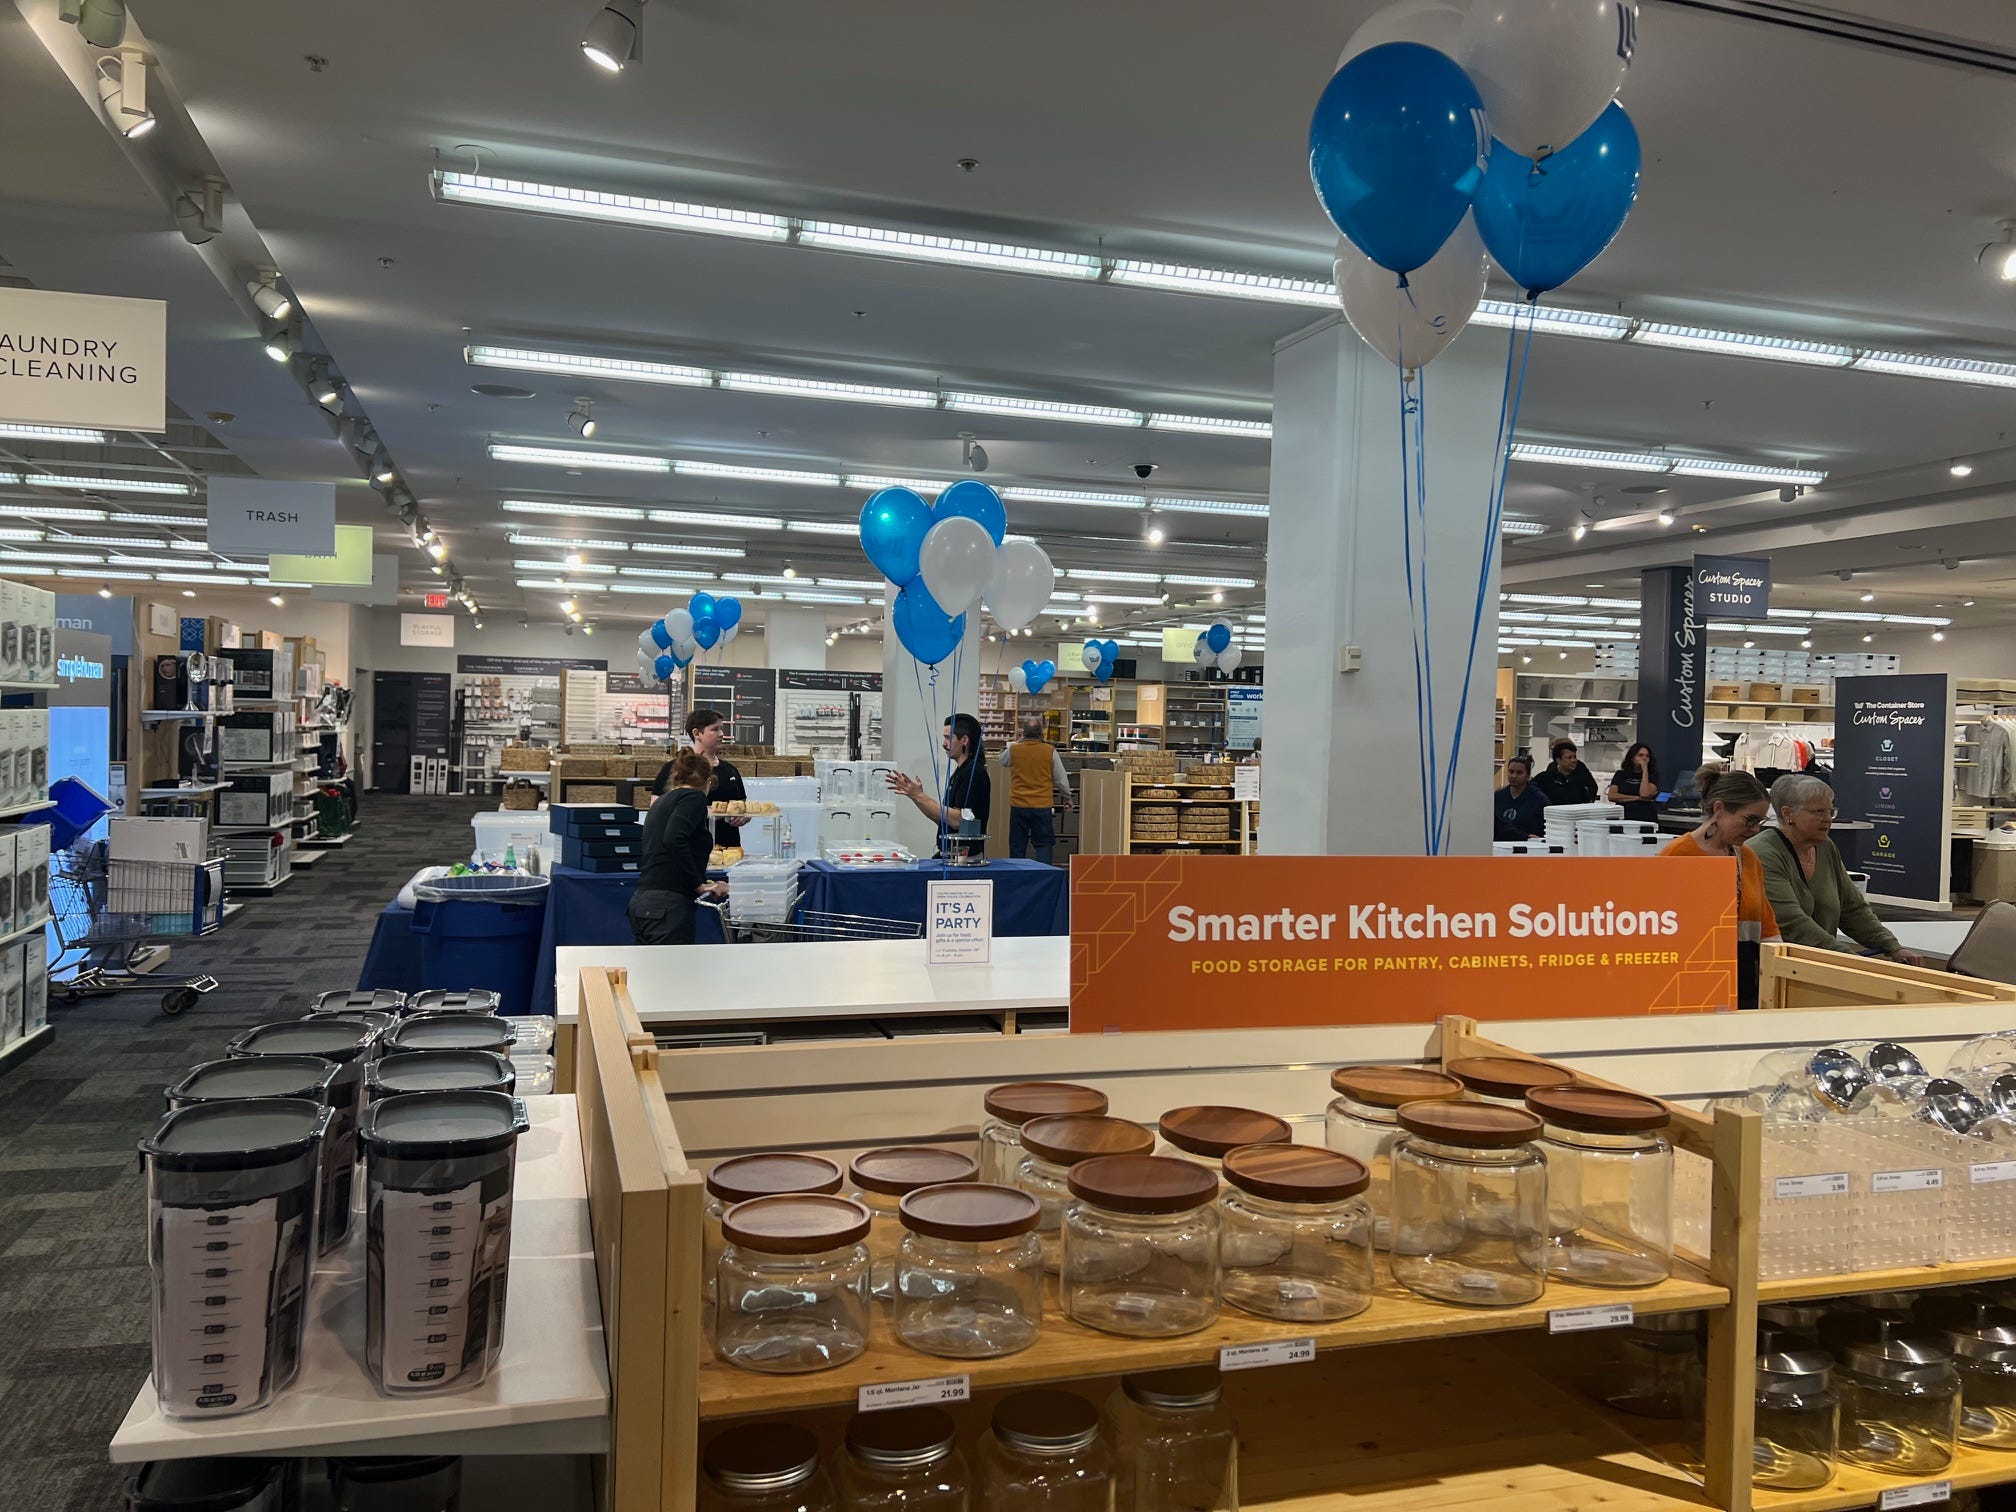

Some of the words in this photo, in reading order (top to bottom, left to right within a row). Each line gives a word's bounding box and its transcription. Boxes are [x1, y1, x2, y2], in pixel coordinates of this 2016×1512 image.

[246, 510, 298, 523] TRASH
[1698, 569, 1731, 585] Custom
[1732, 572, 1763, 591] Spaces
[1709, 592, 1751, 604] STUDIO
[1675, 575, 1705, 649] Spaces
[57, 653, 104, 683] simplehuman
[1672, 652, 1696, 728] Custom
[1877, 701, 1907, 709] Container
[1907, 701, 1925, 709] Store
[1853, 710, 1888, 725] Custom
[1889, 711, 1925, 730] Spaces
[936, 902, 961, 914] IT'S
[965, 902, 975, 914] A
[936, 917, 981, 929] PARTY
[1168, 905, 1336, 942] Smarter
[1349, 902, 1496, 939] Kitchen
[1508, 900, 1679, 937] Solutions
[1192, 960, 1240, 973] FOOD
[1248, 958, 1328, 973] STORAGE
[1334, 957, 1367, 971] FOR
[1375, 956, 1443, 972] PANTRY,
[1449, 954, 1533, 969] CABINETS,
[1539, 953, 1595, 967] FRIDGE
[1600, 953, 1610, 966] &
[1616, 951, 1679, 966] FREEZER
[1288, 1350, 1310, 1359] 24.99
[941, 1388, 964, 1399] 21.99
